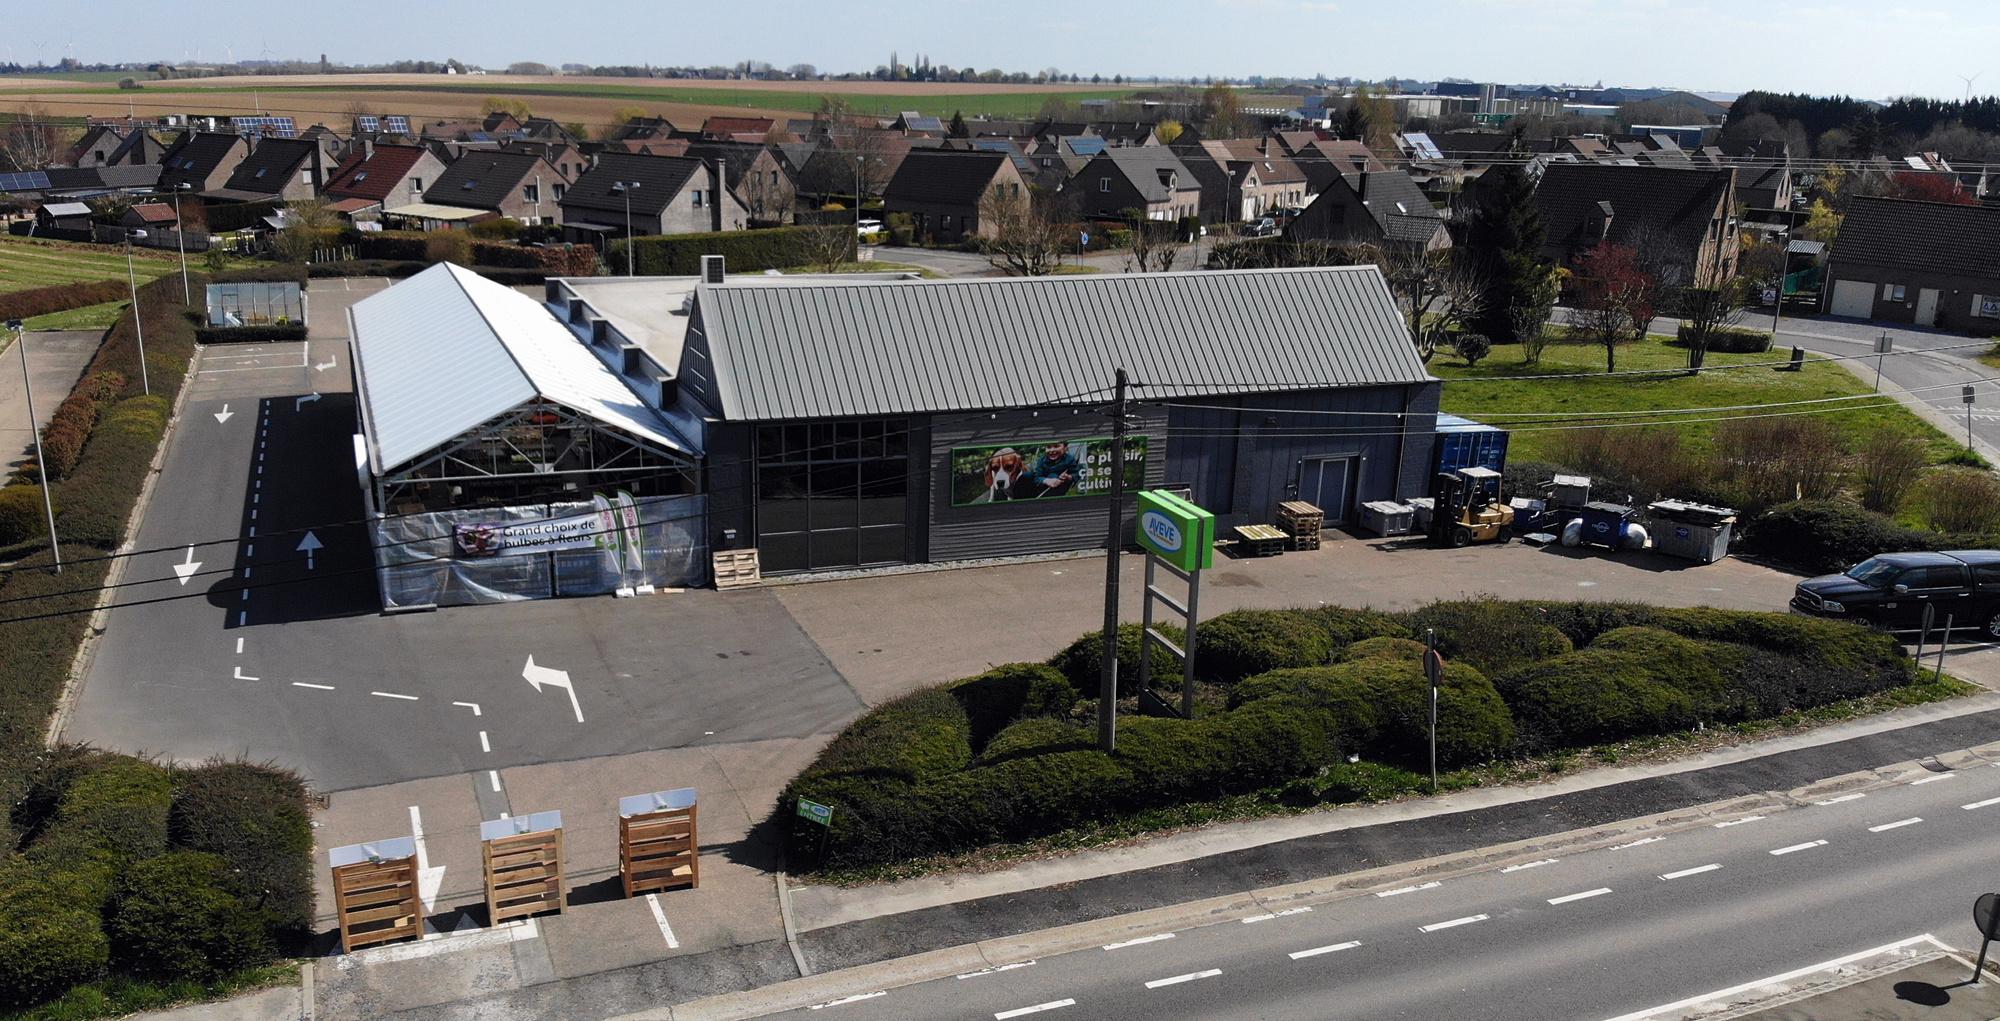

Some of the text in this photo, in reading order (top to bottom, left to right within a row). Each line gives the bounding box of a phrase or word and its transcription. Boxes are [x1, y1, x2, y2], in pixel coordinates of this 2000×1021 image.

[1079, 449, 1143, 466] Le plsir,
[1078, 466, 1112, 480] ça se
[1077, 477, 1128, 491] culti.
[503, 520, 595, 537] Grand choix de
[1149, 517, 1175, 541] AVEVE
[504, 537, 545, 549] bulbes
[558, 532, 592, 544] fleurs
